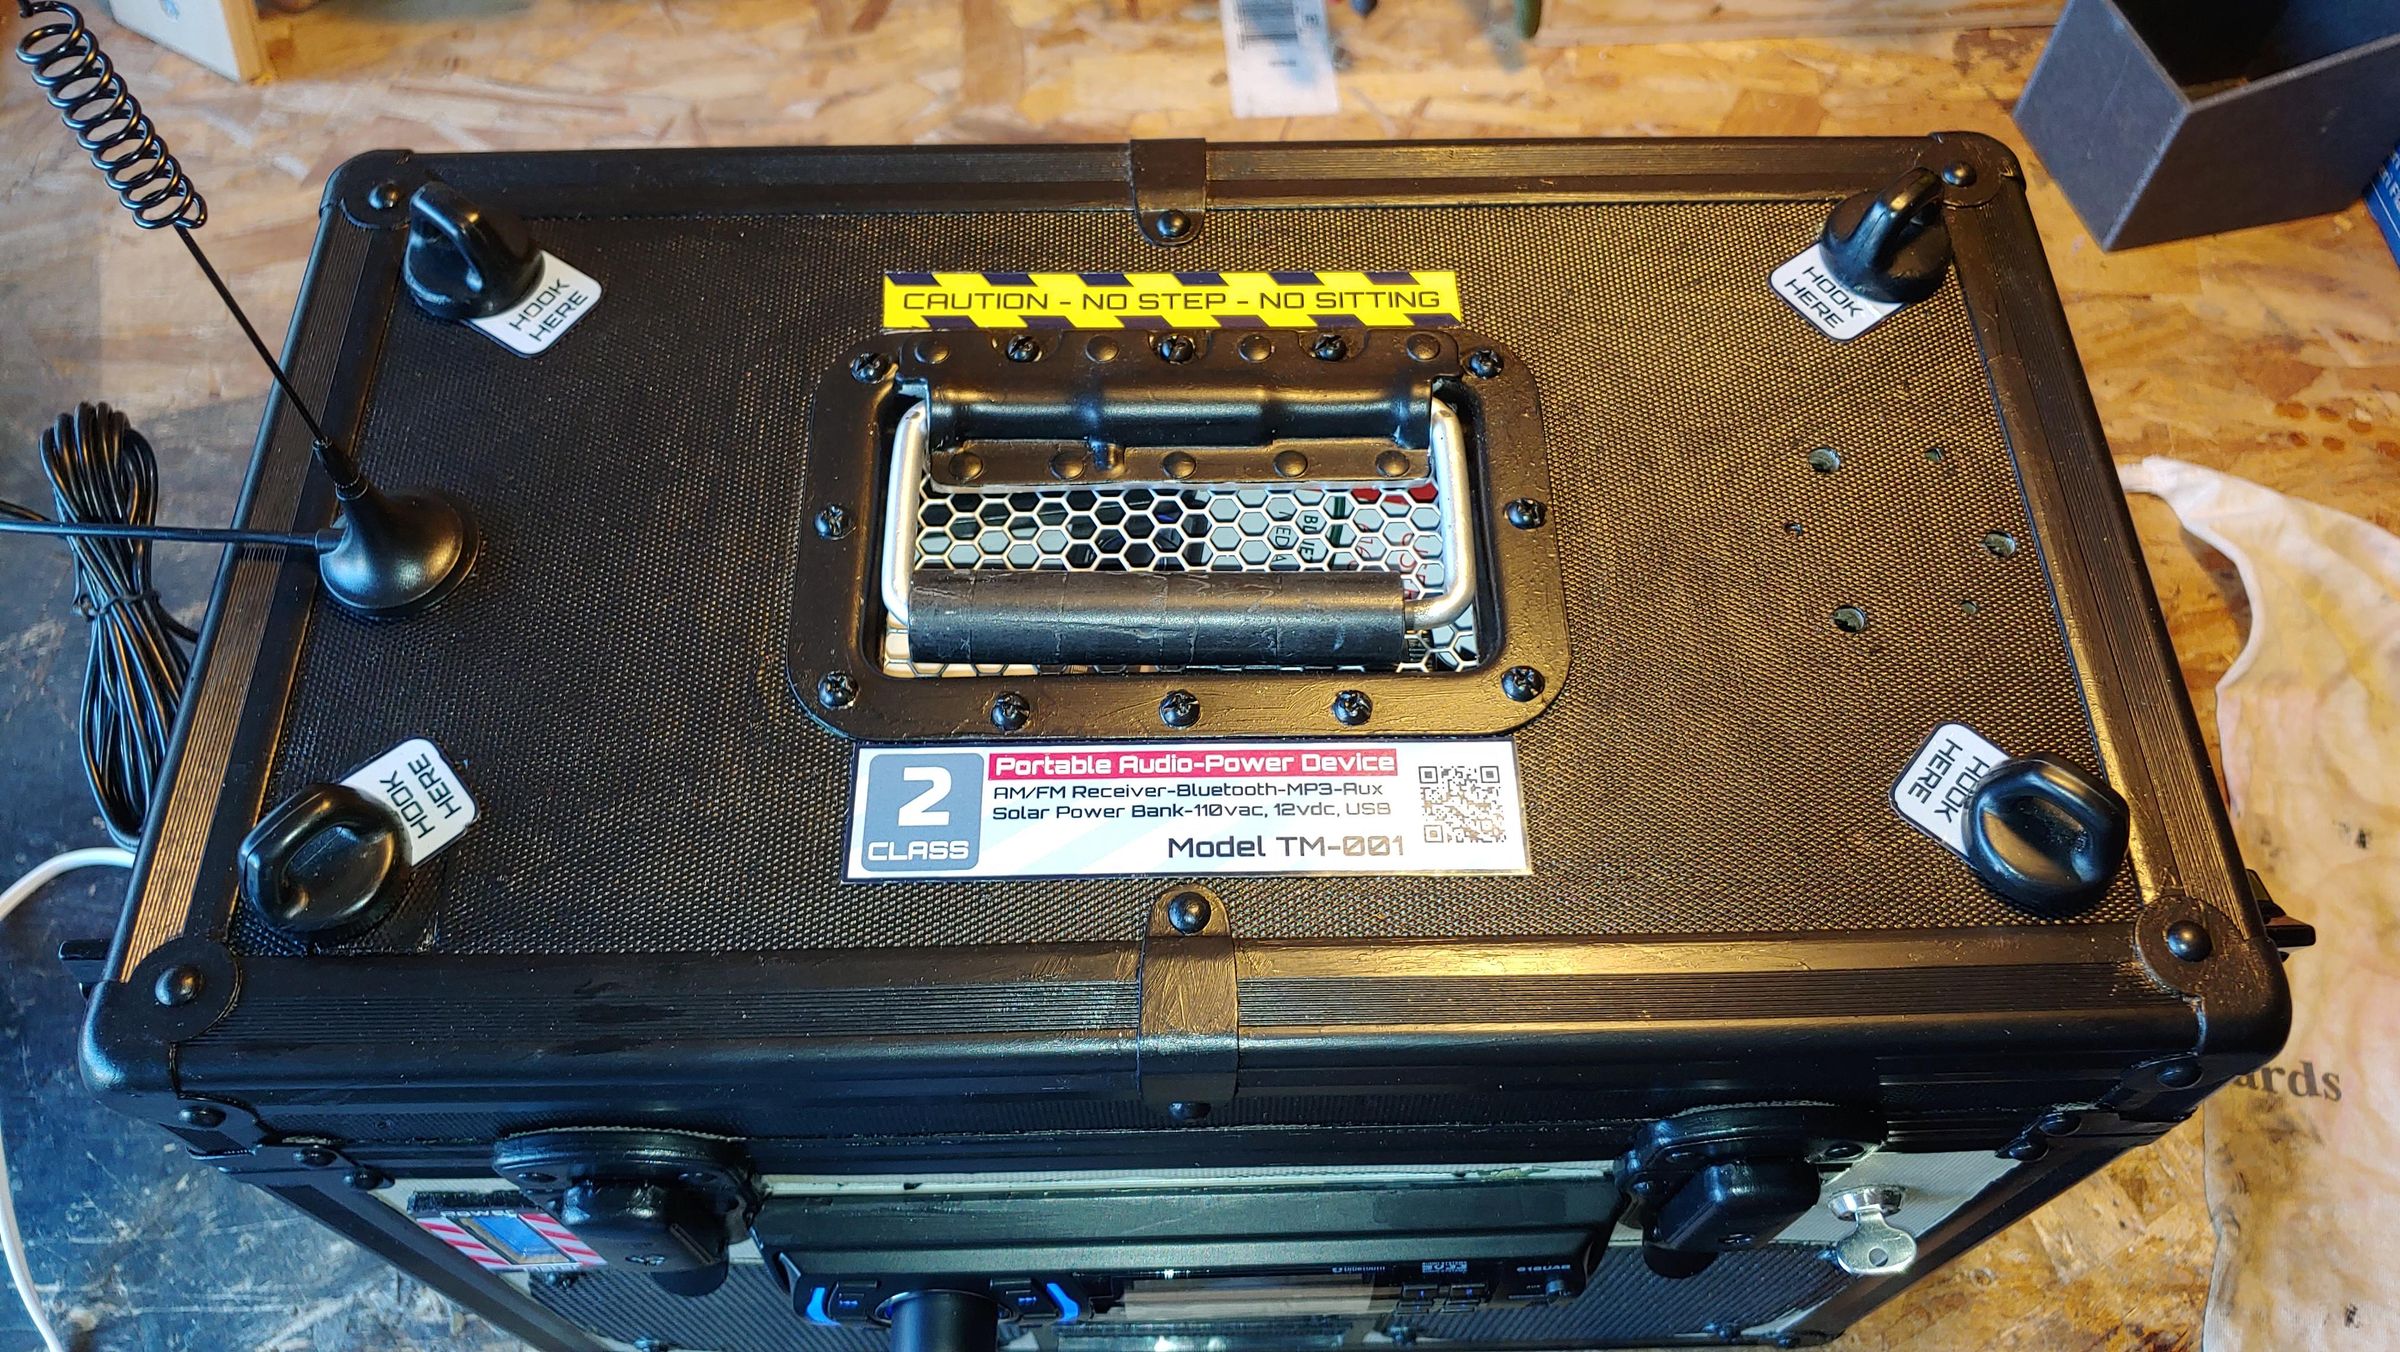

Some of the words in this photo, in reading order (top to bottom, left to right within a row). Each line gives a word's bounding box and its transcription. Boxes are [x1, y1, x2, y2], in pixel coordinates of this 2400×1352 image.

[509, 278, 570, 331] HOOK
[529, 290, 588, 341] HERE
[904, 293, 1048, 310] CAUTION
[1083, 293, 1134, 310] NO
[1139, 293, 1226, 310] STEP
[1260, 292, 1305, 310] NO
[1316, 291, 1440, 309] SITTING
[1784, 278, 1845, 329] HERE
[1802, 266, 1863, 317] HOOK
[407, 753, 462, 819] HERE
[995, 754, 1112, 776] Portable
[1119, 753, 1294, 775] Audio-Power
[1302, 752, 1396, 773] Device
[1907, 738, 1963, 804] HERE
[379, 770, 436, 839] HOOK
[897, 766, 953, 827] 2
[993, 806, 1050, 820] Solar
[1056, 805, 1125, 819] Power
[1131, 803, 1268, 819] Bank-110vac,
[1273, 802, 1341, 818] 12vdc,
[1346, 802, 1391, 816] USB
[994, 785, 1066, 800] AM/FM
[1072, 782, 1383, 798] Receiver-Bluetooth-MP3-Aux
[868, 840, 970, 862] CLASS
[1168, 835, 1266, 859] Model
[1276, 835, 1404, 857] TM-001
